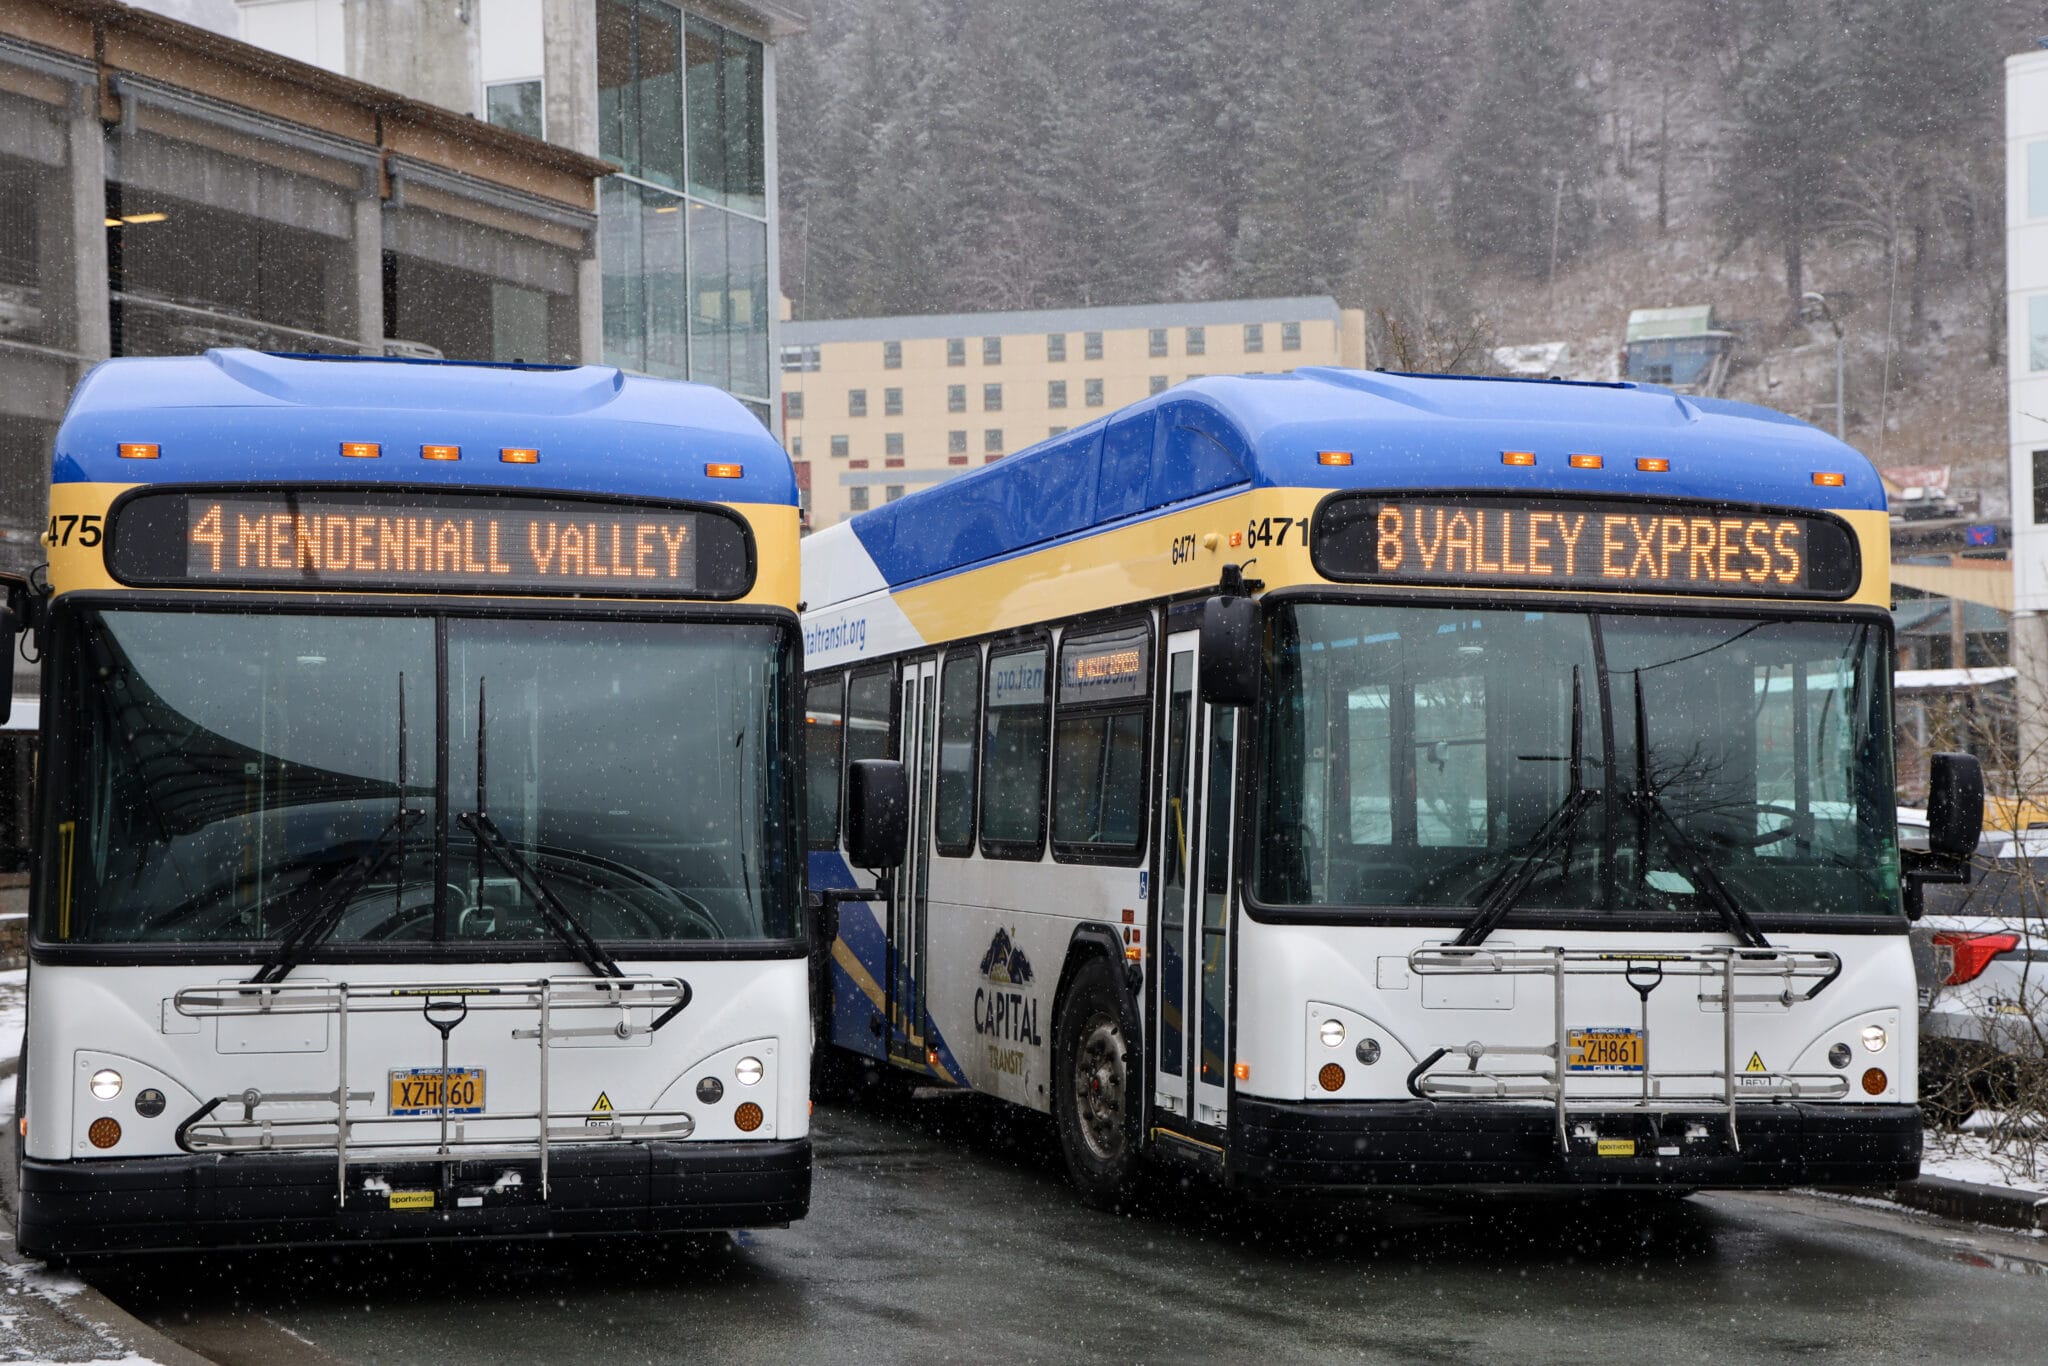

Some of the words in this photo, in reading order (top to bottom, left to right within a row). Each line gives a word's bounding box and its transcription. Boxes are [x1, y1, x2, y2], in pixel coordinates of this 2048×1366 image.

[192, 504, 224, 573] 4
[237, 512, 510, 574] MENDENHALL
[530, 520, 687, 578] VALLEY
[1172, 533, 1196, 565] 6471
[1247, 517, 1309, 549] 6471
[1377, 506, 1402, 571] 8
[1415, 508, 1585, 576] VALLEY
[1603, 515, 1800, 584] EXPRESS
[974, 987, 1041, 1047] CAPITAL
[988, 1045, 1025, 1076] TRANSIT
[392, 1195, 433, 1205] sportworks
